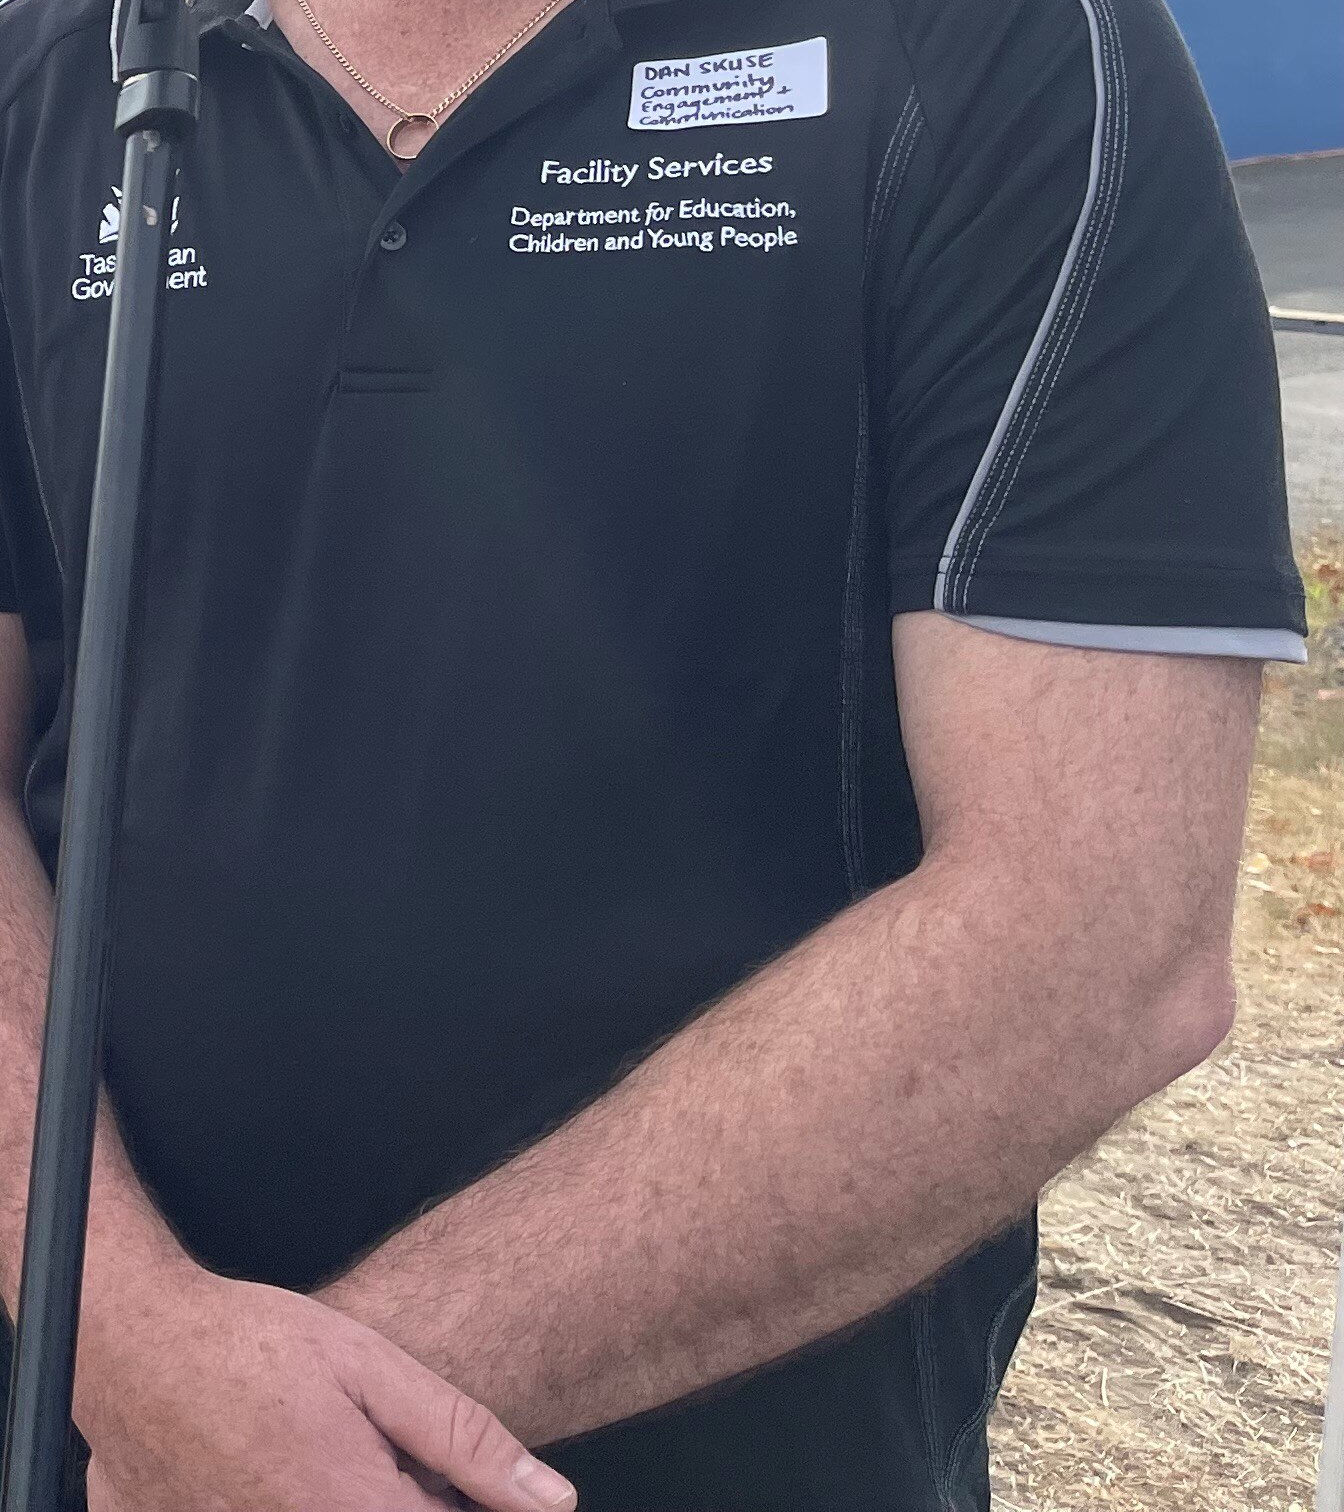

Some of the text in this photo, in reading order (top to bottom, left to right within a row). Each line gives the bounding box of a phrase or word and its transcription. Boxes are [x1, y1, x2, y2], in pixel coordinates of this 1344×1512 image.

[645, 52, 774, 81] DAN SKUSE
[641, 74, 775, 99] Community
[639, 103, 794, 126] Communication
[641, 88, 768, 119] Engagement
[540, 153, 773, 187] Facility Services
[510, 197, 797, 231] Department for Education,
[509, 226, 799, 253] Children and Young People
[79, 247, 196, 276] Tasan
[71, 265, 208, 300] Govent
